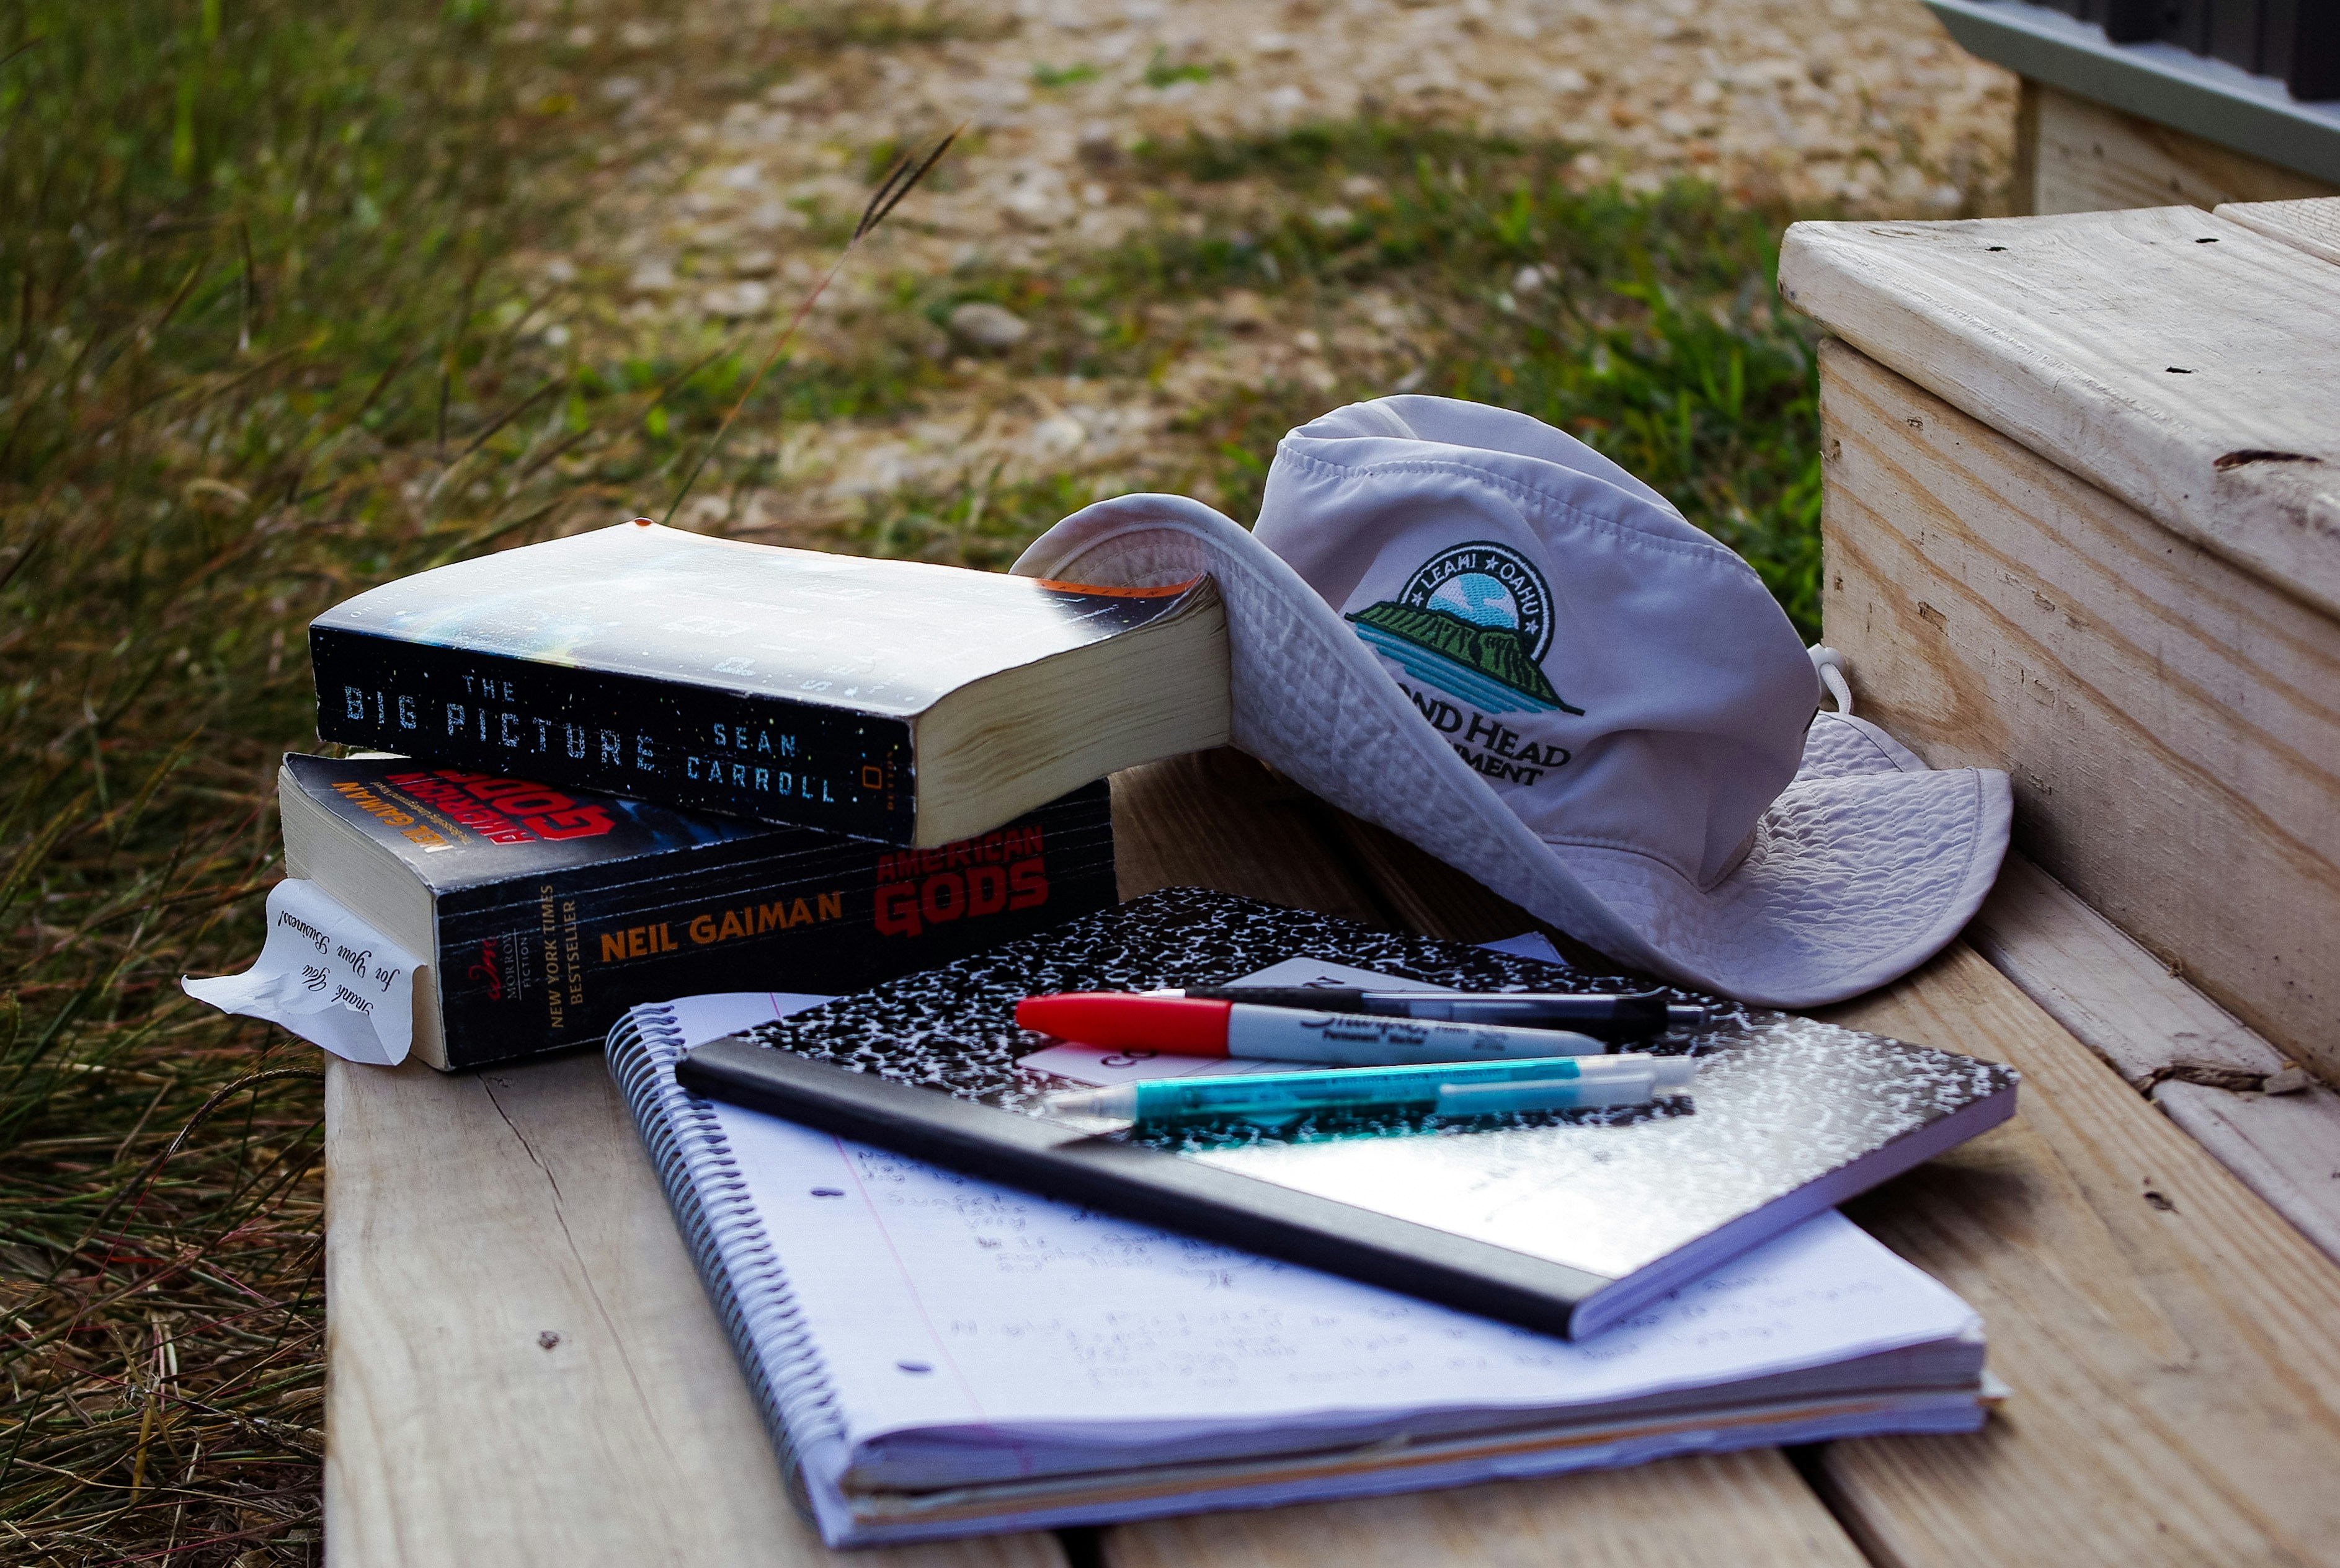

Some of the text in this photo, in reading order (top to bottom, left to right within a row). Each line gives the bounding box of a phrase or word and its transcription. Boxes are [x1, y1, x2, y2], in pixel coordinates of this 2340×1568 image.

[1500, 563, 1539, 614] OAHU
[463, 675, 515, 702] THE
[345, 686, 655, 771] BIG PICTURE
[713, 722, 796, 758] SEAN
[1464, 712, 1571, 767] HEAD
[687, 756, 835, 804] CARROLL
[1454, 743, 1544, 786] MENT
[331, 782, 454, 853] NEIL GAIMAN
[876, 825, 1043, 882] AMERICAN
[873, 856, 1049, 939] GODS
[277, 910, 401, 992] for Your Business!
[563, 900, 583, 1006] BESTSELLER
[600, 890, 842, 963] NEIL GAIMAN
[301, 964, 331, 992] You
[521, 936, 531, 988] FICTION
[541, 884, 564, 1028] NEW YORK TIMES
